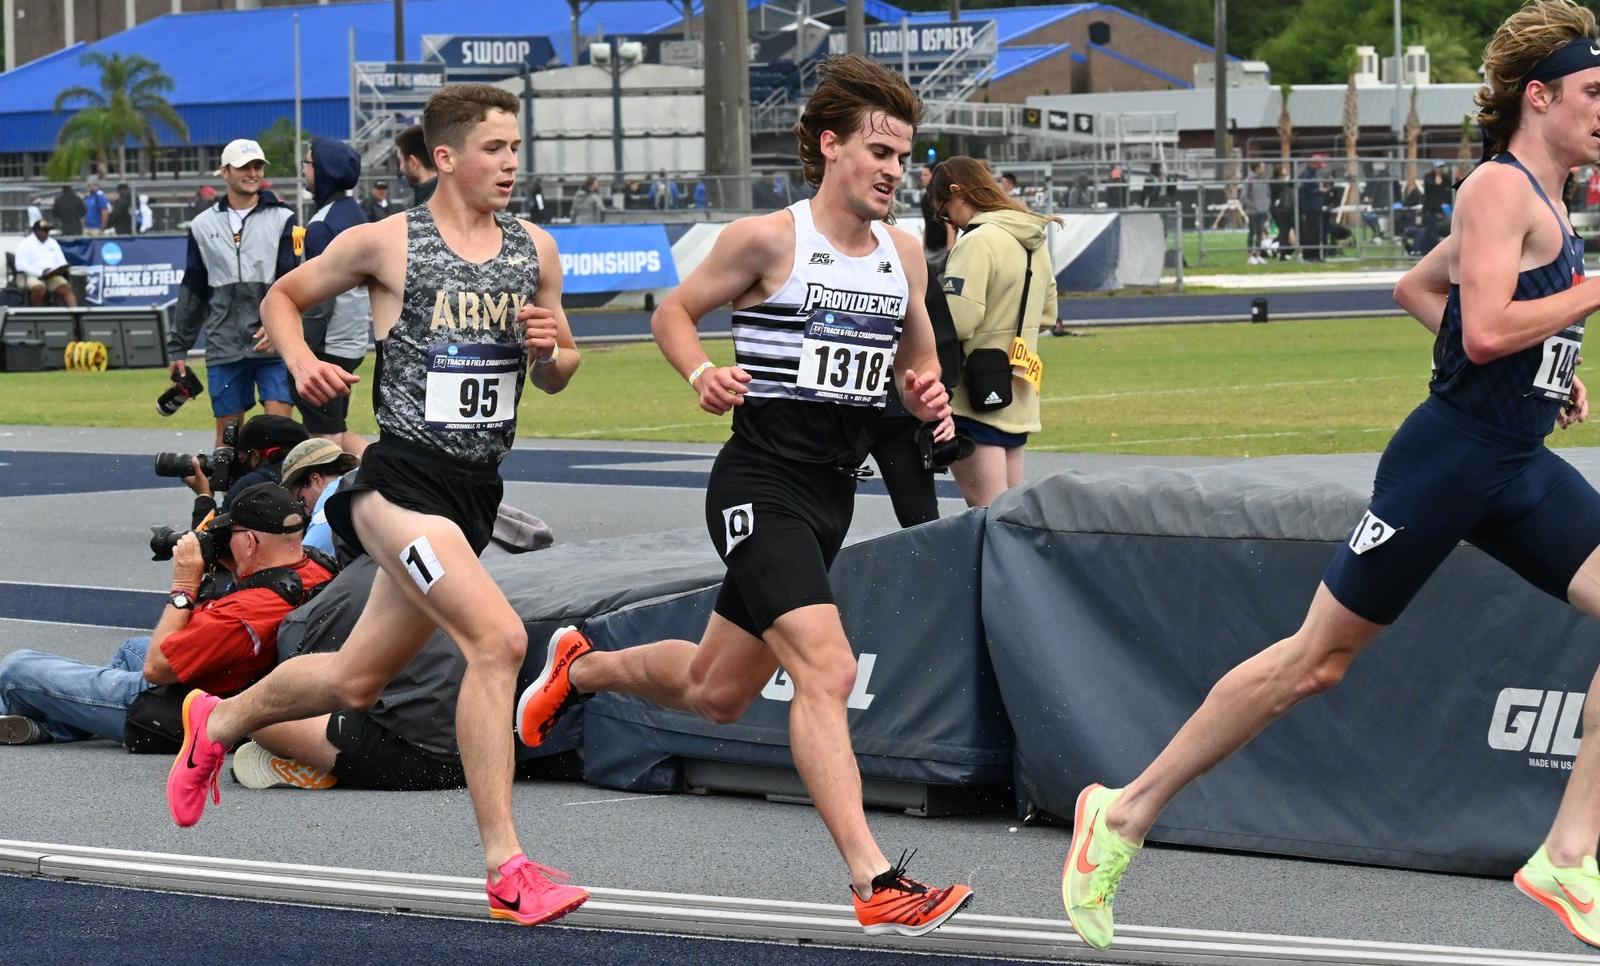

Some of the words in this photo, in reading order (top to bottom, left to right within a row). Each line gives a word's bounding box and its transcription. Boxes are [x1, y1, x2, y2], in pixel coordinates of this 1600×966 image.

[462, 41, 530, 64] SWOOP
[870, 29, 918, 53] FLORIA
[922, 26, 974, 51] OSPREYS
[559, 250, 661, 276] PIONSHIPS
[104, 271, 141, 287] TRACK
[430, 291, 528, 334] ARMY
[803, 283, 902, 318] PROVIDENCE
[823, 327, 840, 335] TRACK
[815, 346, 884, 392] 1318
[459, 378, 500, 418] 95
[406, 545, 433, 584] 1
[565, 641, 582, 660] new
[1487, 687, 1586, 756] GIL
[1528, 757, 1549, 768] MADE
[1550, 760, 1559, 768] IN
